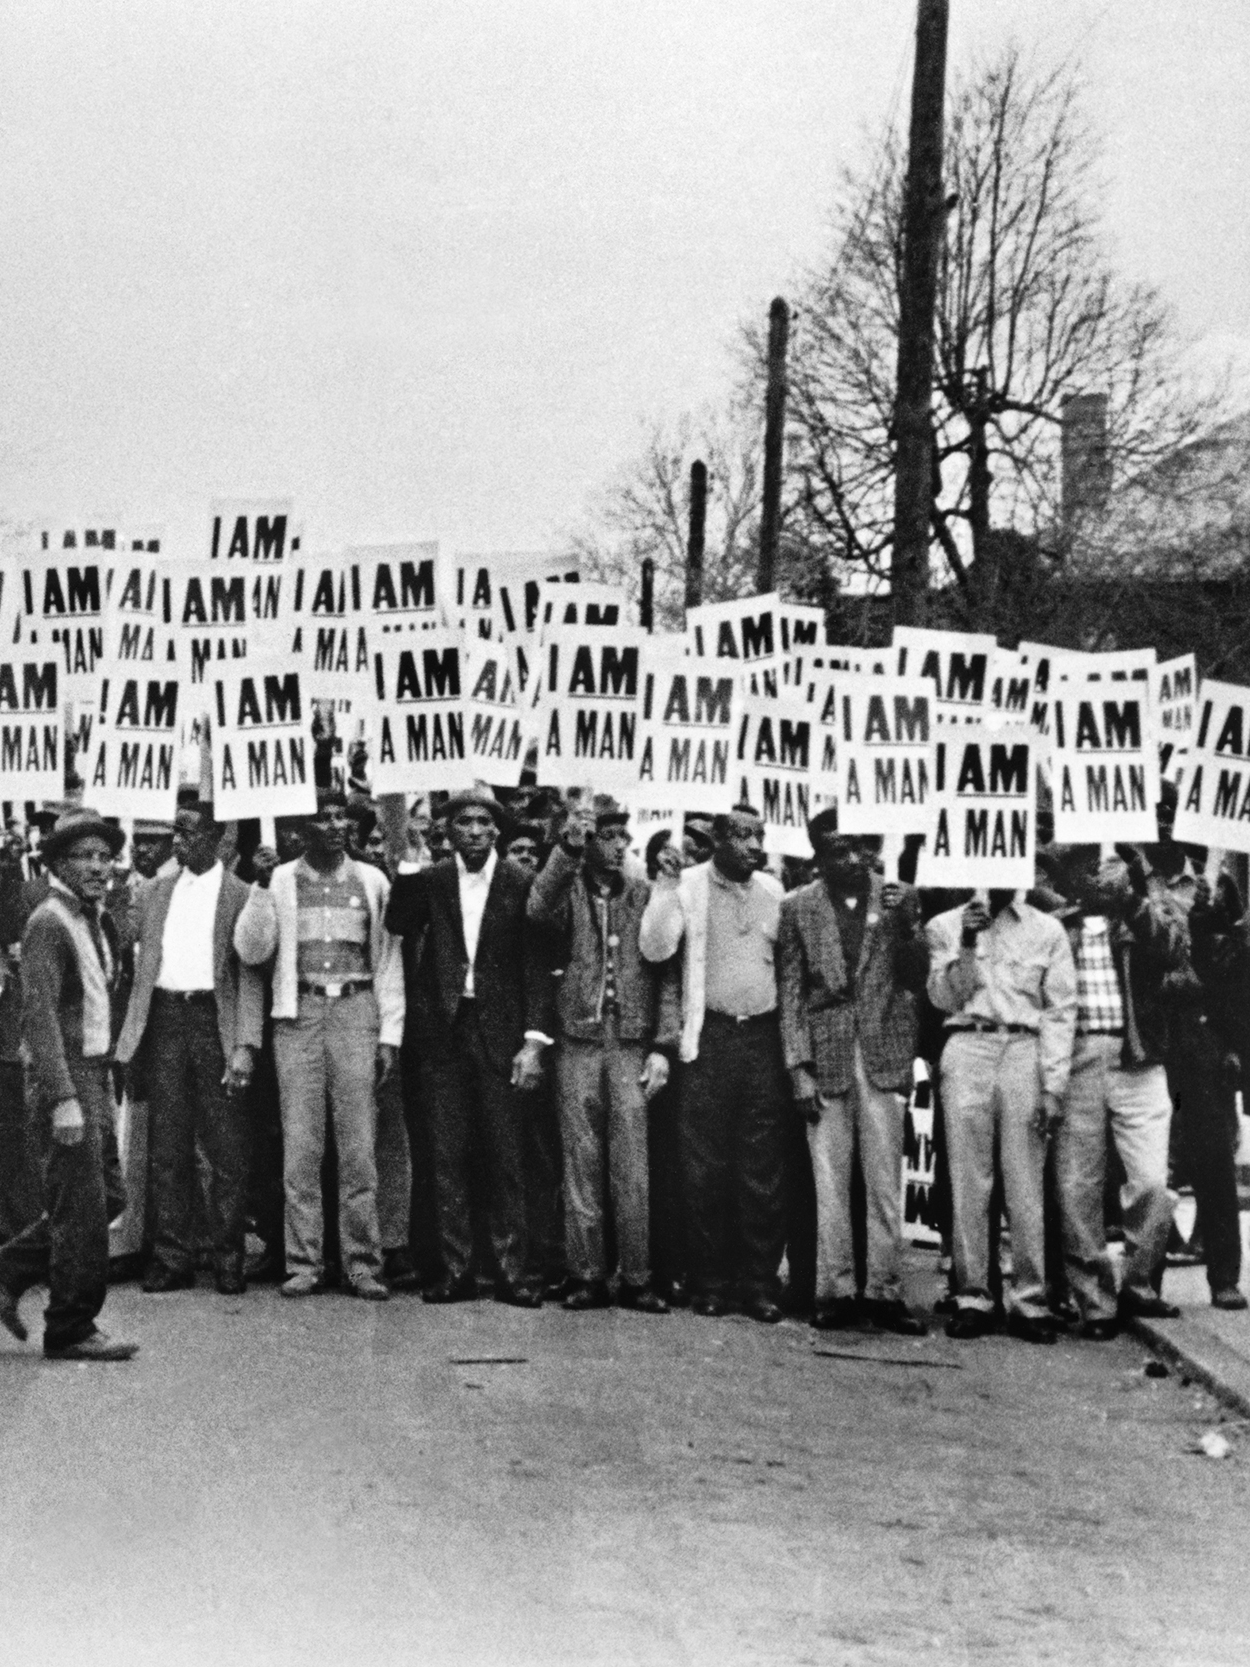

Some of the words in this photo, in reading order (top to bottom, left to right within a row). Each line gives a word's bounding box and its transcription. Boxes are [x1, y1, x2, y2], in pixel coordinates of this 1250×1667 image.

[211, 516, 222, 559] I
[227, 514, 288, 560] AM
[23, 570, 34, 615] I
[42, 565, 101, 615] AM
[163, 578, 171, 624] I
[181, 576, 246, 625] AM
[293, 568, 305, 612] I
[351, 565, 361, 610] I
[372, 559, 436, 611] AM
[314, 627, 349, 672] MA
[716, 611, 775, 660] AM
[374, 653, 385, 700] I
[396, 647, 461, 702] AM
[549, 644, 558, 692] I
[568, 645, 640, 698] AM
[98, 678, 110, 725] I
[115, 679, 179, 729] AM
[215, 680, 226, 727] I
[237, 672, 302, 726] AM
[643, 673, 654, 720] I
[663, 674, 734, 725] AM
[843, 695, 852, 741] I
[864, 694, 930, 743] AM
[1196, 699, 1214, 749] I
[1, 724, 58, 771] MAN
[380, 716, 396, 764] A
[406, 711, 465, 762] MAN
[546, 708, 561, 757] A
[574, 709, 637, 761] MAN
[736, 713, 750, 761] I
[754, 716, 811, 768] AM
[1055, 700, 1065, 748] I
[1075, 700, 1142, 749] AM
[92, 741, 107, 787] A
[117, 741, 174, 791] MAN
[221, 743, 237, 789] A
[247, 737, 306, 788] MAN
[639, 736, 654, 781] A
[667, 737, 729, 785] MAN
[846, 758, 862, 804] A
[936, 743, 945, 791] I
[956, 743, 1030, 794] AM
[762, 777, 813, 830] MAN
[1061, 764, 1076, 812] A
[1085, 764, 1147, 812] MAN
[1185, 764, 1204, 813] A
[934, 808, 950, 857] A
[964, 808, 1028, 858] MAN
